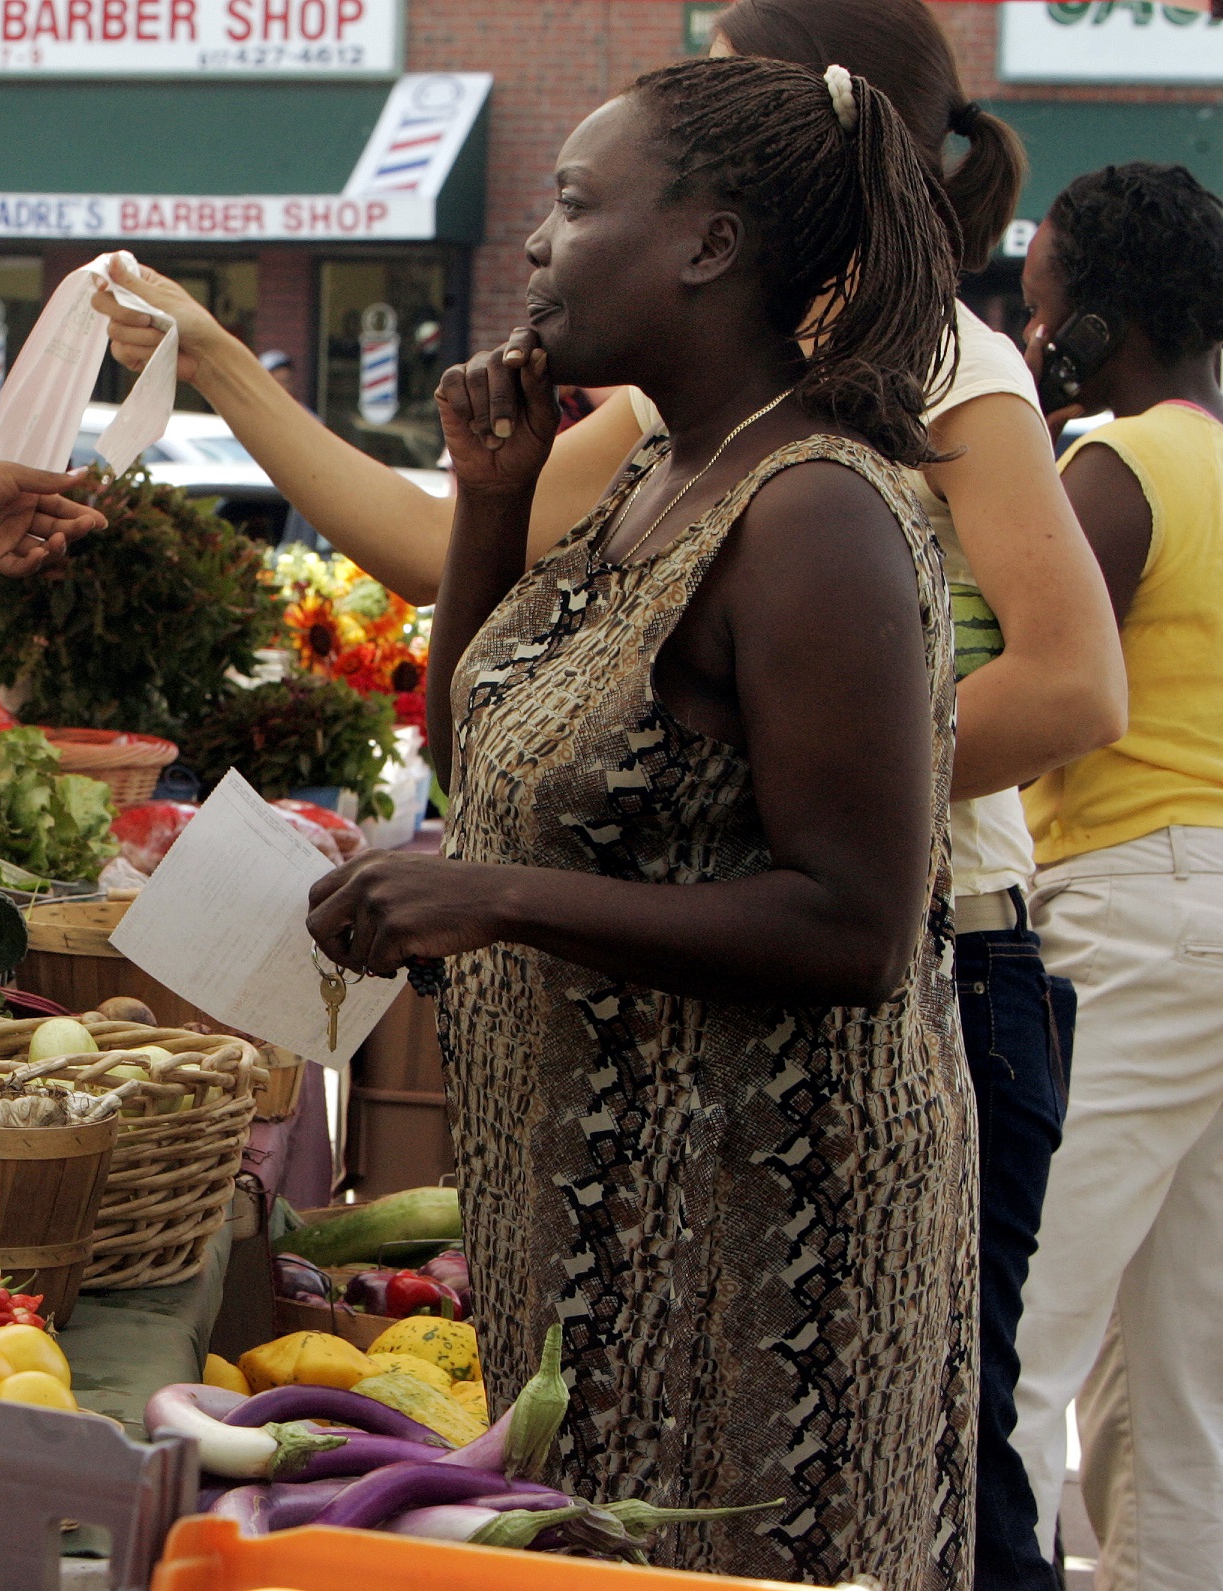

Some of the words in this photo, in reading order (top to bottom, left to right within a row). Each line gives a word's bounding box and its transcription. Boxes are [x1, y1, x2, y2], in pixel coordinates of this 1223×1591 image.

[0, 0, 198, 42] BARBER
[225, 0, 366, 42] SHOP
[119, 200, 265, 232] BARBER
[281, 200, 389, 232] SHOP
